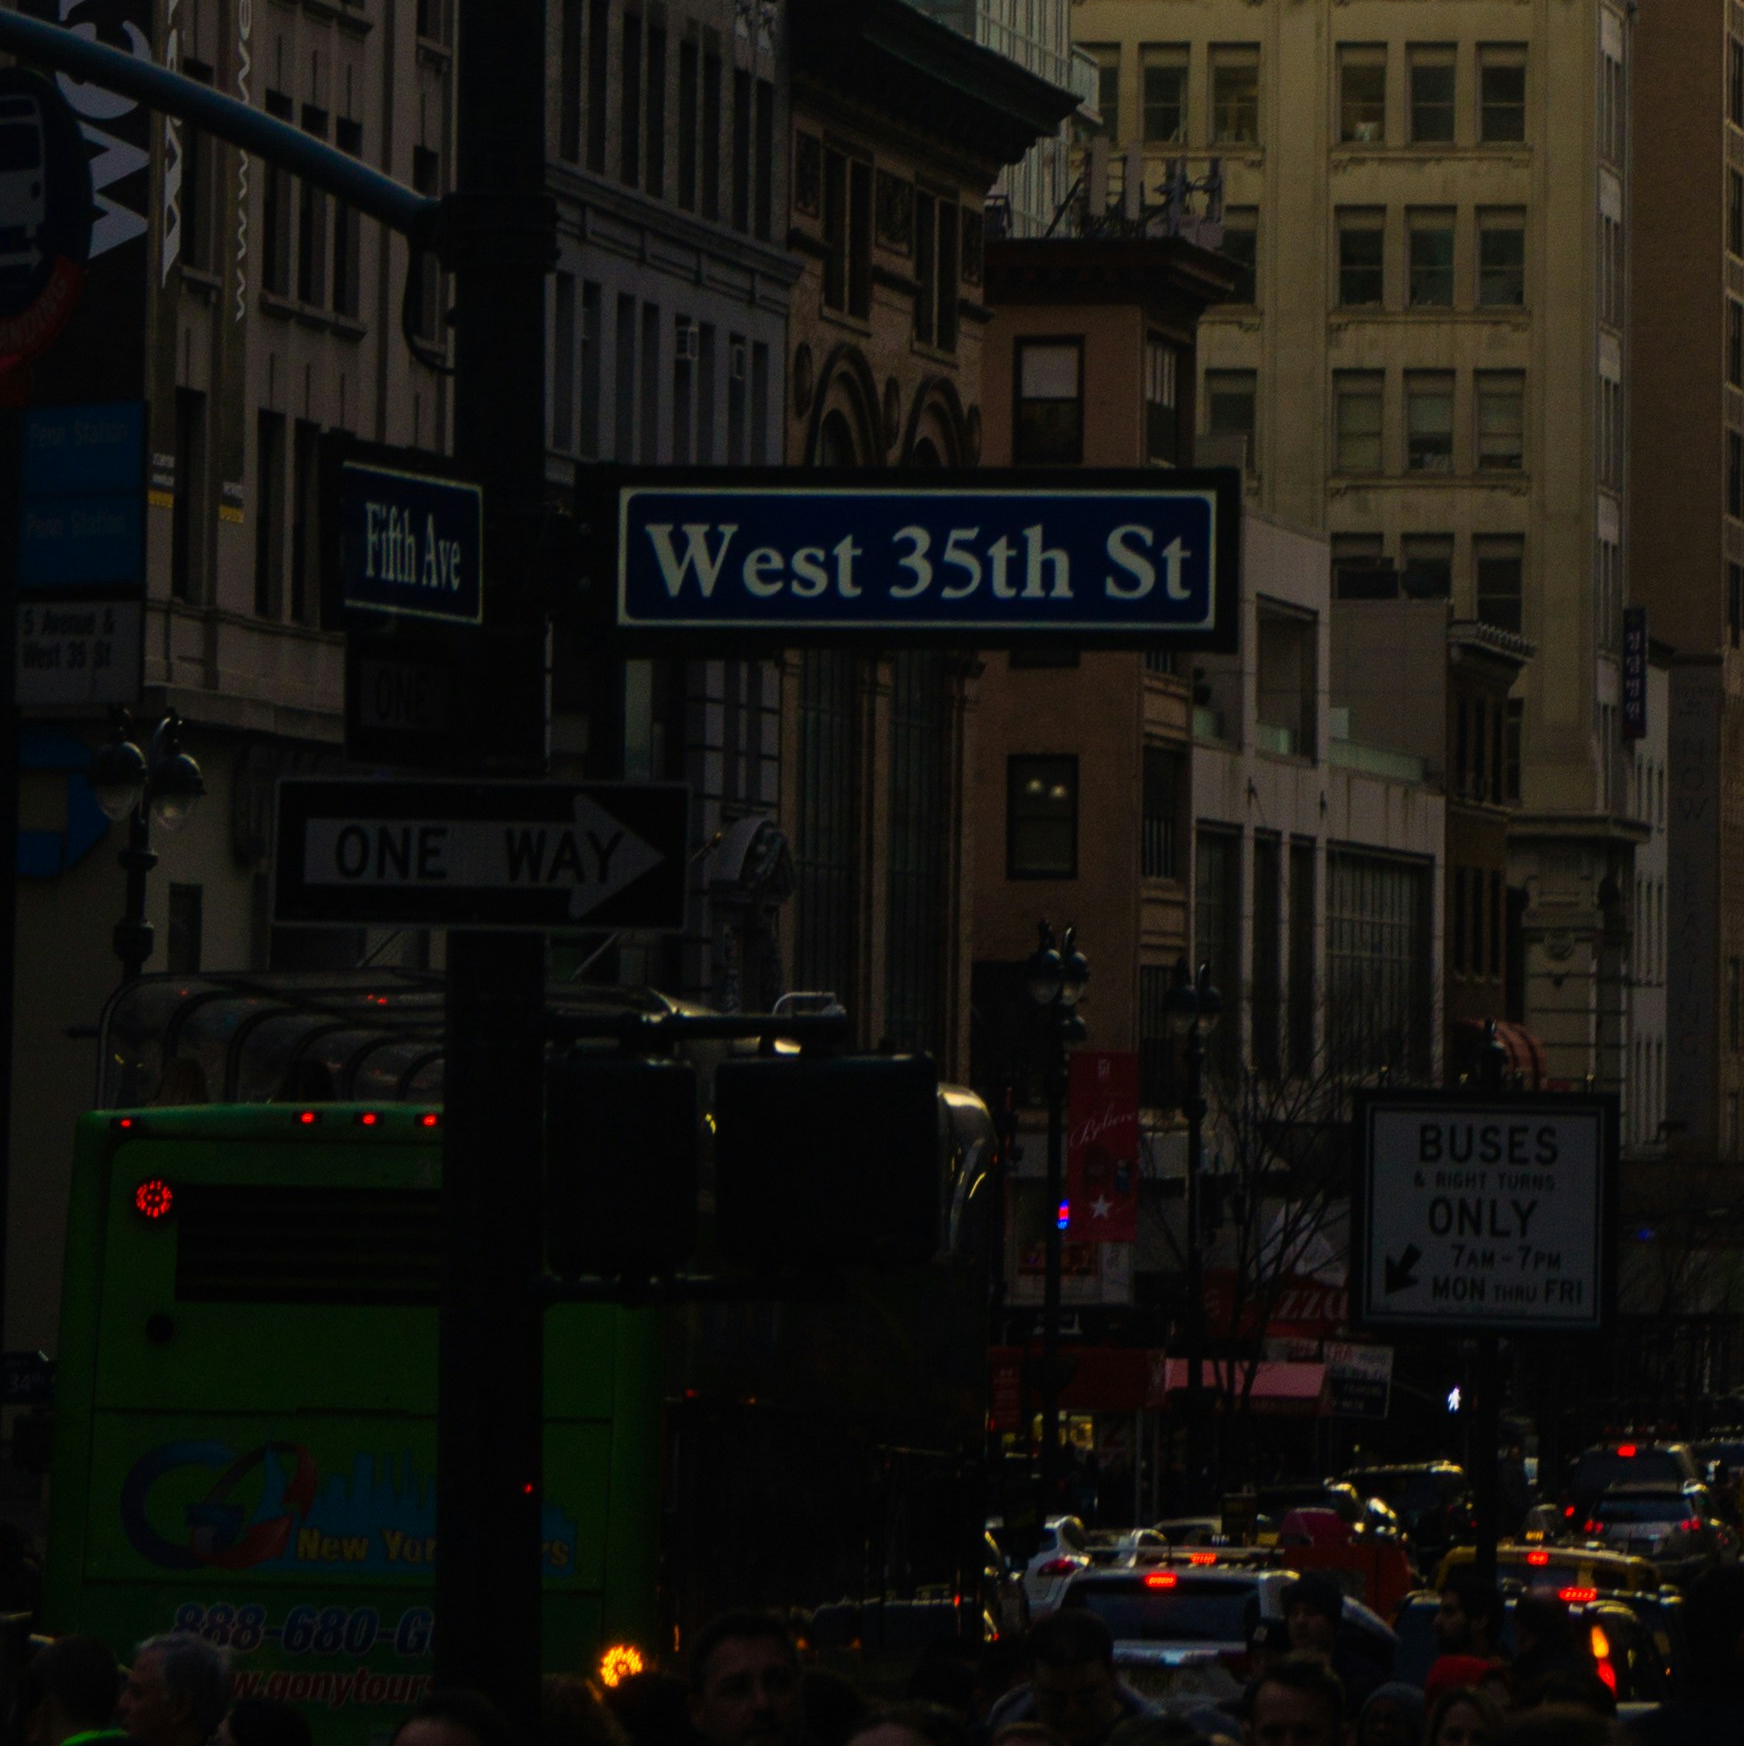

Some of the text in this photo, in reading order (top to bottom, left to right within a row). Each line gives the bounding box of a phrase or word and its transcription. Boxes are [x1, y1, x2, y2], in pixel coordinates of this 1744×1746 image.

[364, 501, 462, 592] Fifth Ave
[645, 522, 1192, 601] West 35th St
[336, 824, 624, 883] ONE WAY
[1419, 1124, 1558, 1165] BUSES
[1414, 1172, 1556, 1191] & RIGHT TURNS
[1428, 1196, 1538, 1238] ONLY
[1432, 1276, 1583, 1304] MON THRU FRI
[296, 1526, 438, 1564] New Yor
[171, 1601, 438, 1657] 888-680-G
